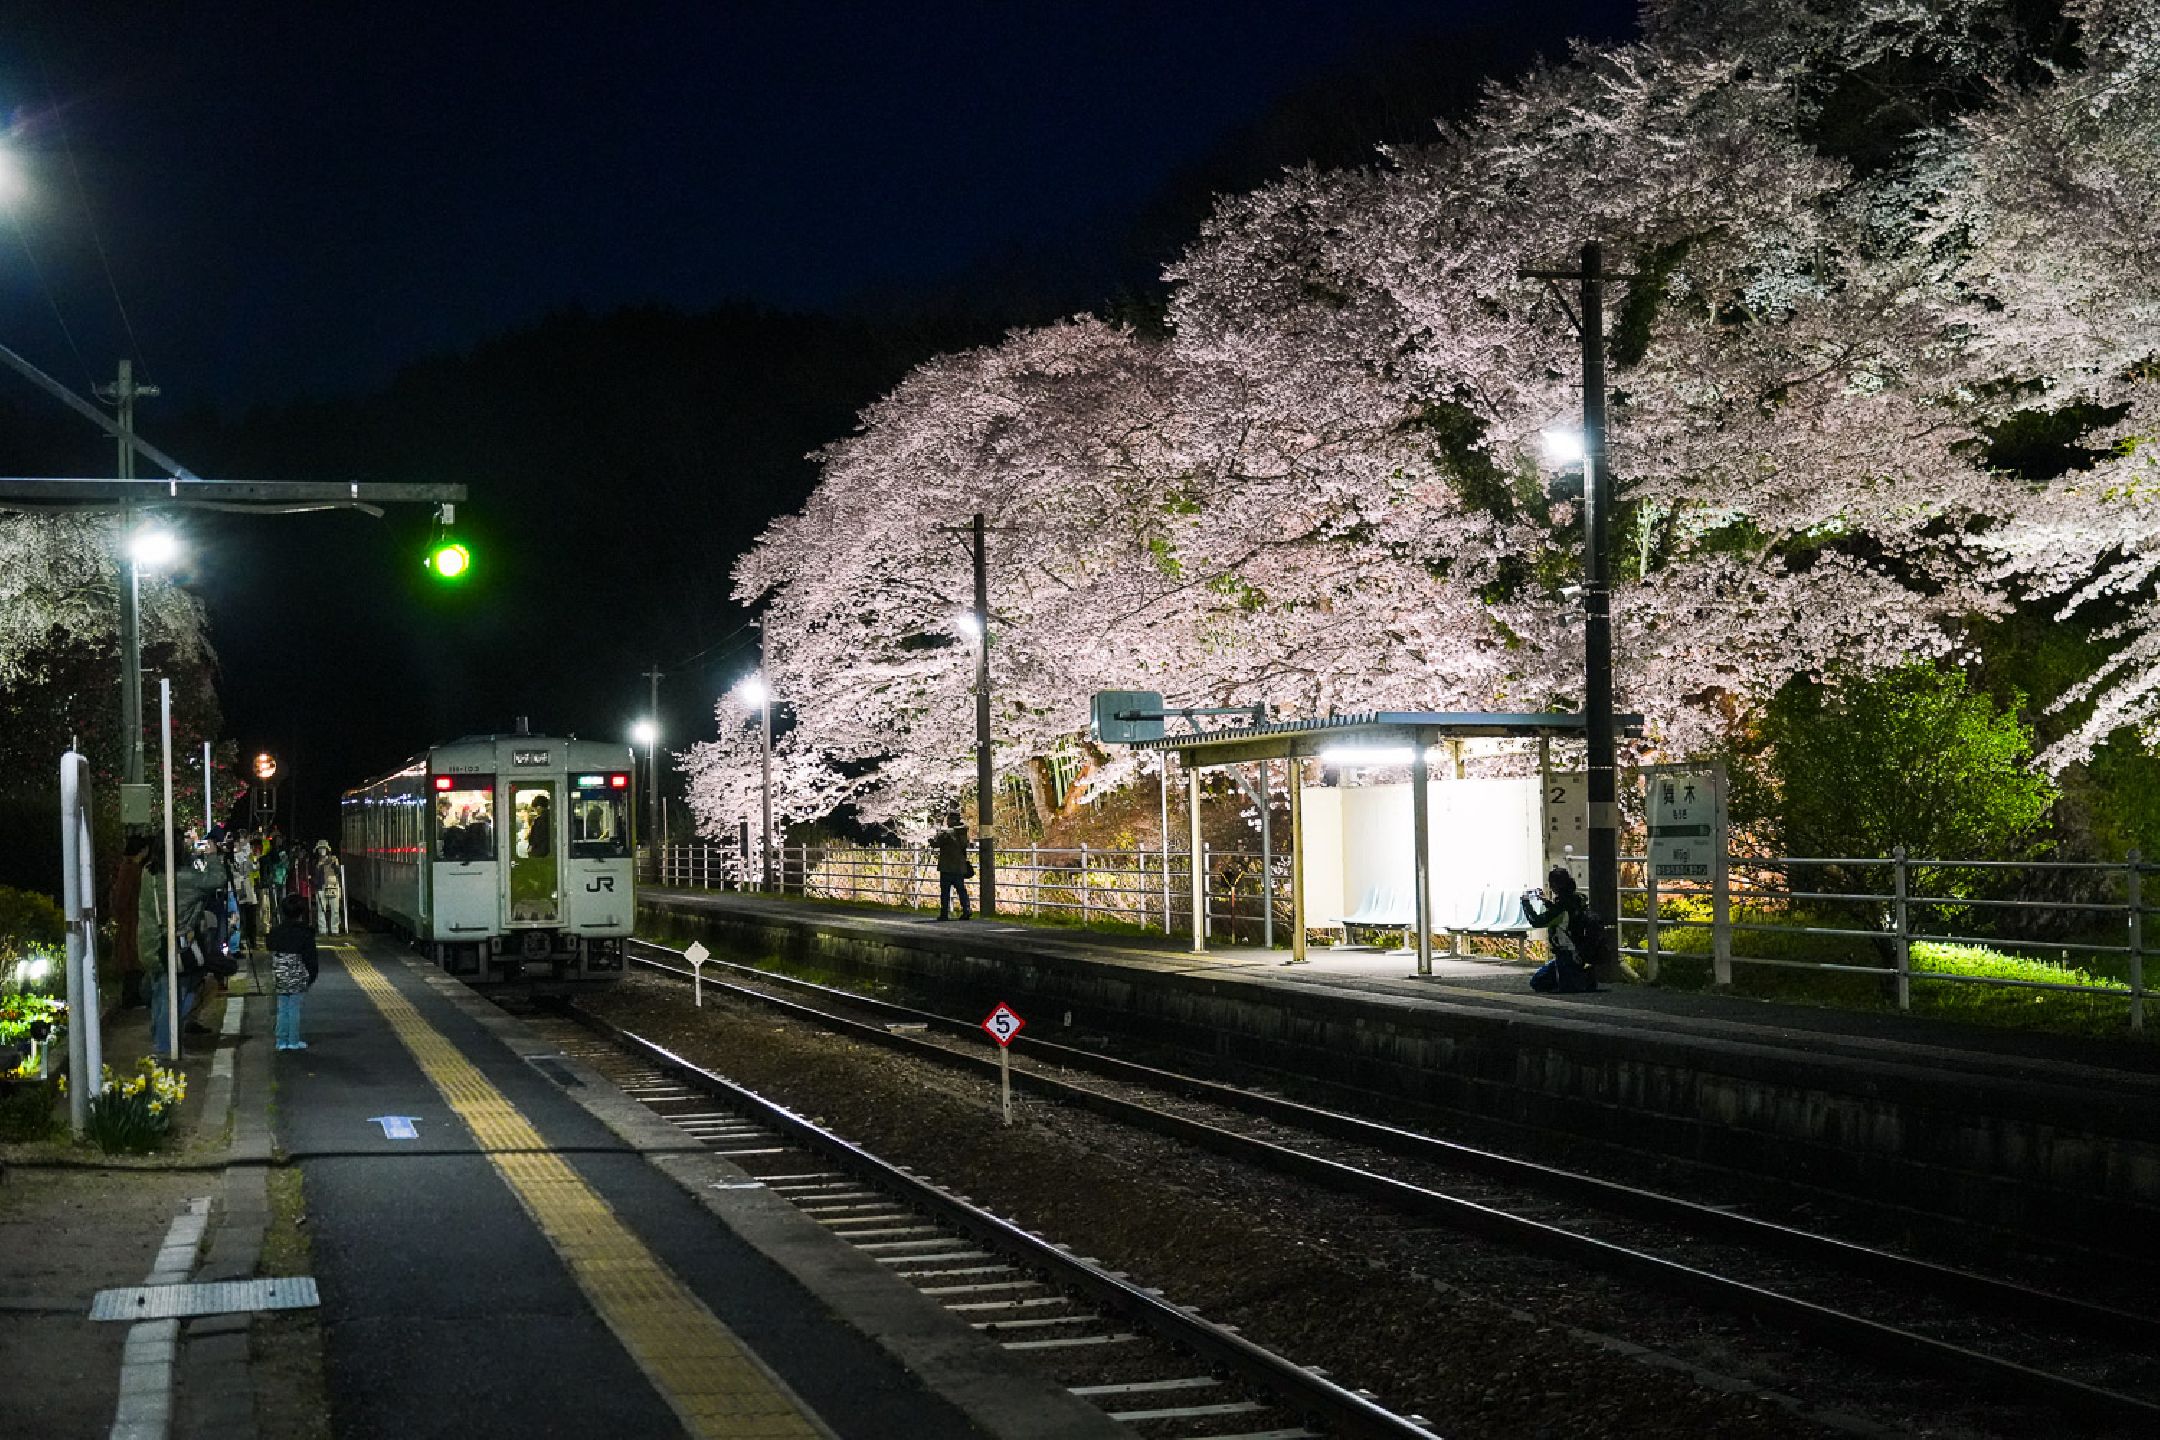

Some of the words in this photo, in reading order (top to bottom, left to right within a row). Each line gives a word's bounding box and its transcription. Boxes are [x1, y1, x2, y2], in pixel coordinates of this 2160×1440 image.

[1550, 786, 1566, 804] 2
[586, 876, 614, 892] JR
[996, 1014, 1010, 1034] 5
